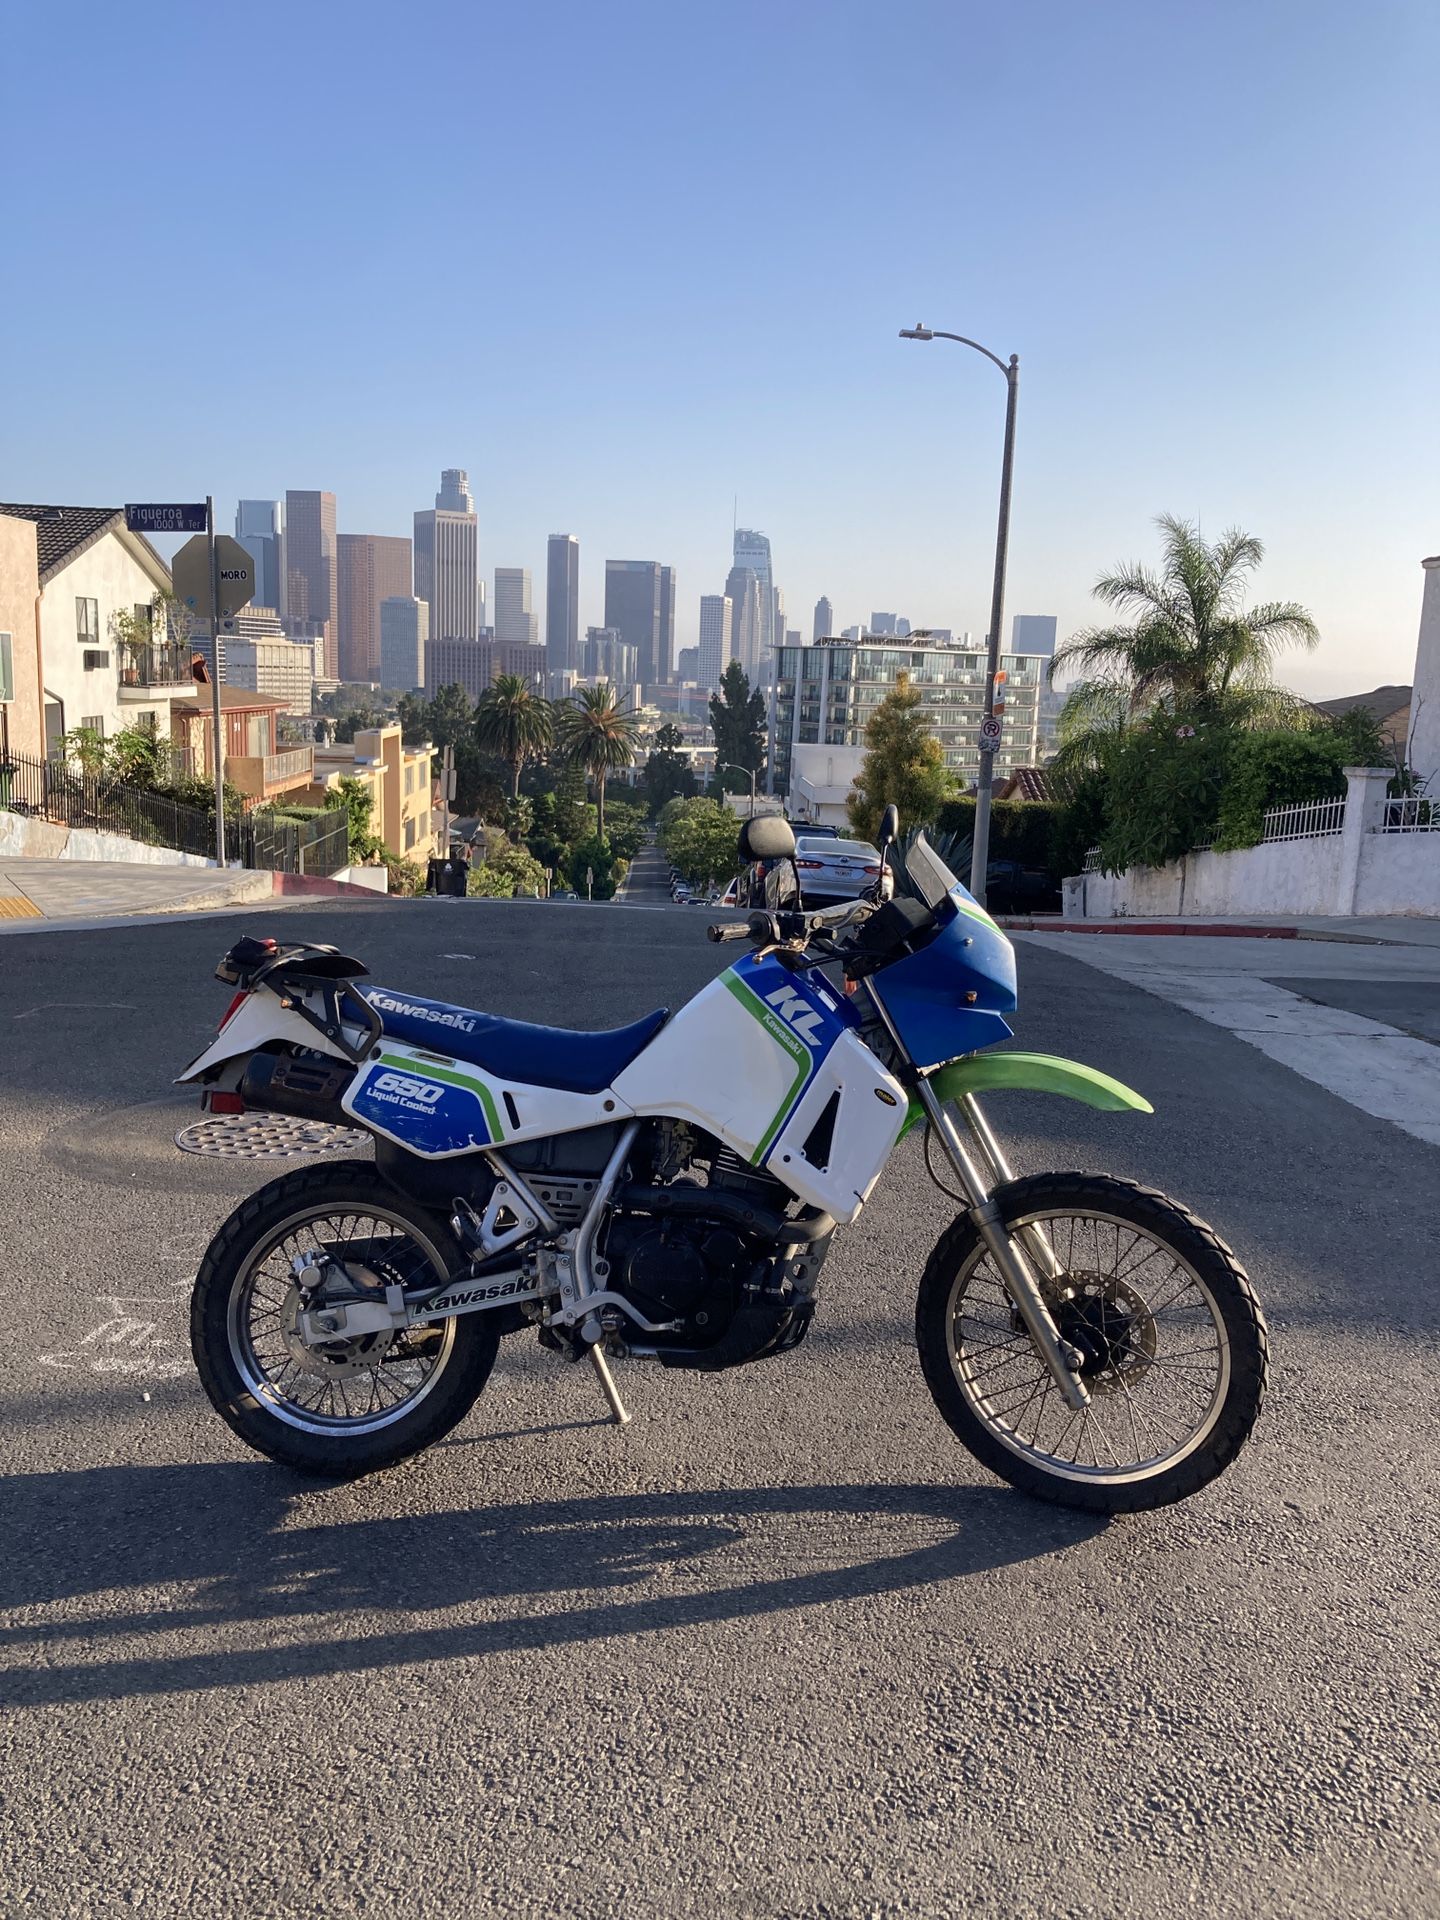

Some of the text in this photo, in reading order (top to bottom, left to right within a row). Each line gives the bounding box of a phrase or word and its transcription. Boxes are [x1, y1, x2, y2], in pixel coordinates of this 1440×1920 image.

[130, 506, 183, 524] Figueroa
[153, 520, 201, 529] 1000 W Ter
[220, 570, 247, 580] MORO
[365, 991, 477, 1033] Kawasaki
[764, 985, 825, 1046] KL
[762, 1013, 804, 1055] Kawasaki
[366, 1087, 436, 1115] Liquid Cooled
[374, 1073, 445, 1104] 650
[414, 1276, 537, 1315] Kawasaki
